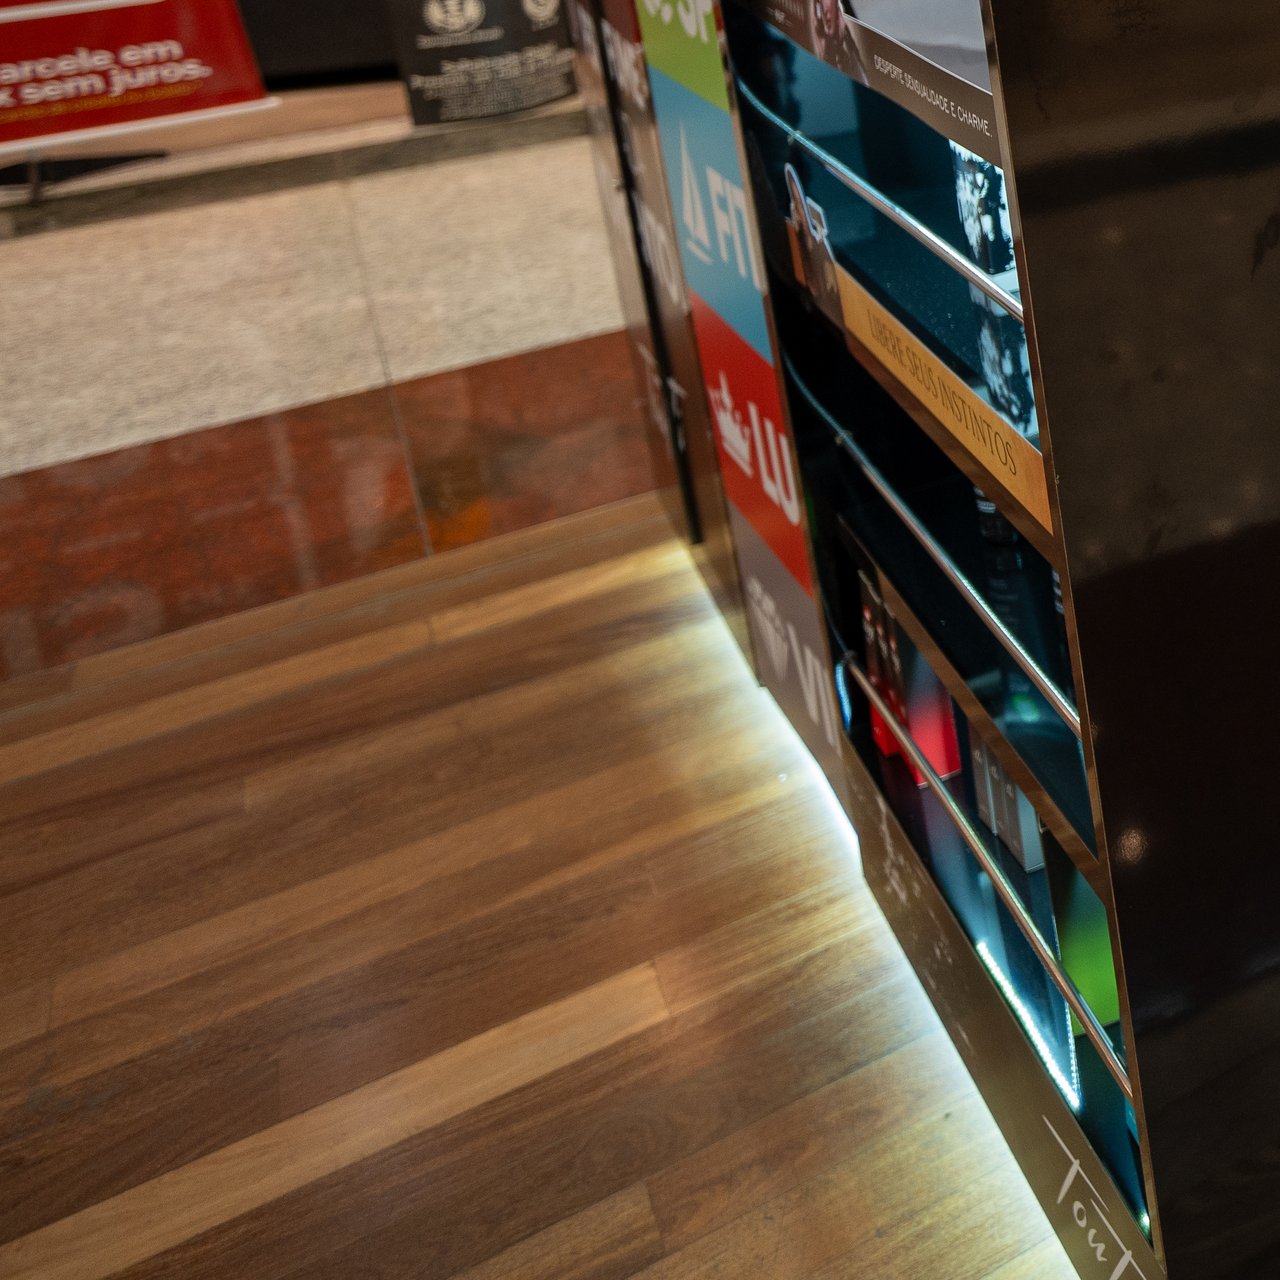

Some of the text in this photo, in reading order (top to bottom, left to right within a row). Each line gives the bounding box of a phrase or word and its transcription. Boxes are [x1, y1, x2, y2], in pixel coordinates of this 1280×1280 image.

[904, 72, 950, 115] SENSUALIDADE
[950, 101, 957, 118] E
[866, 308, 1018, 477] LIBERE SEUS INSTINTOS
